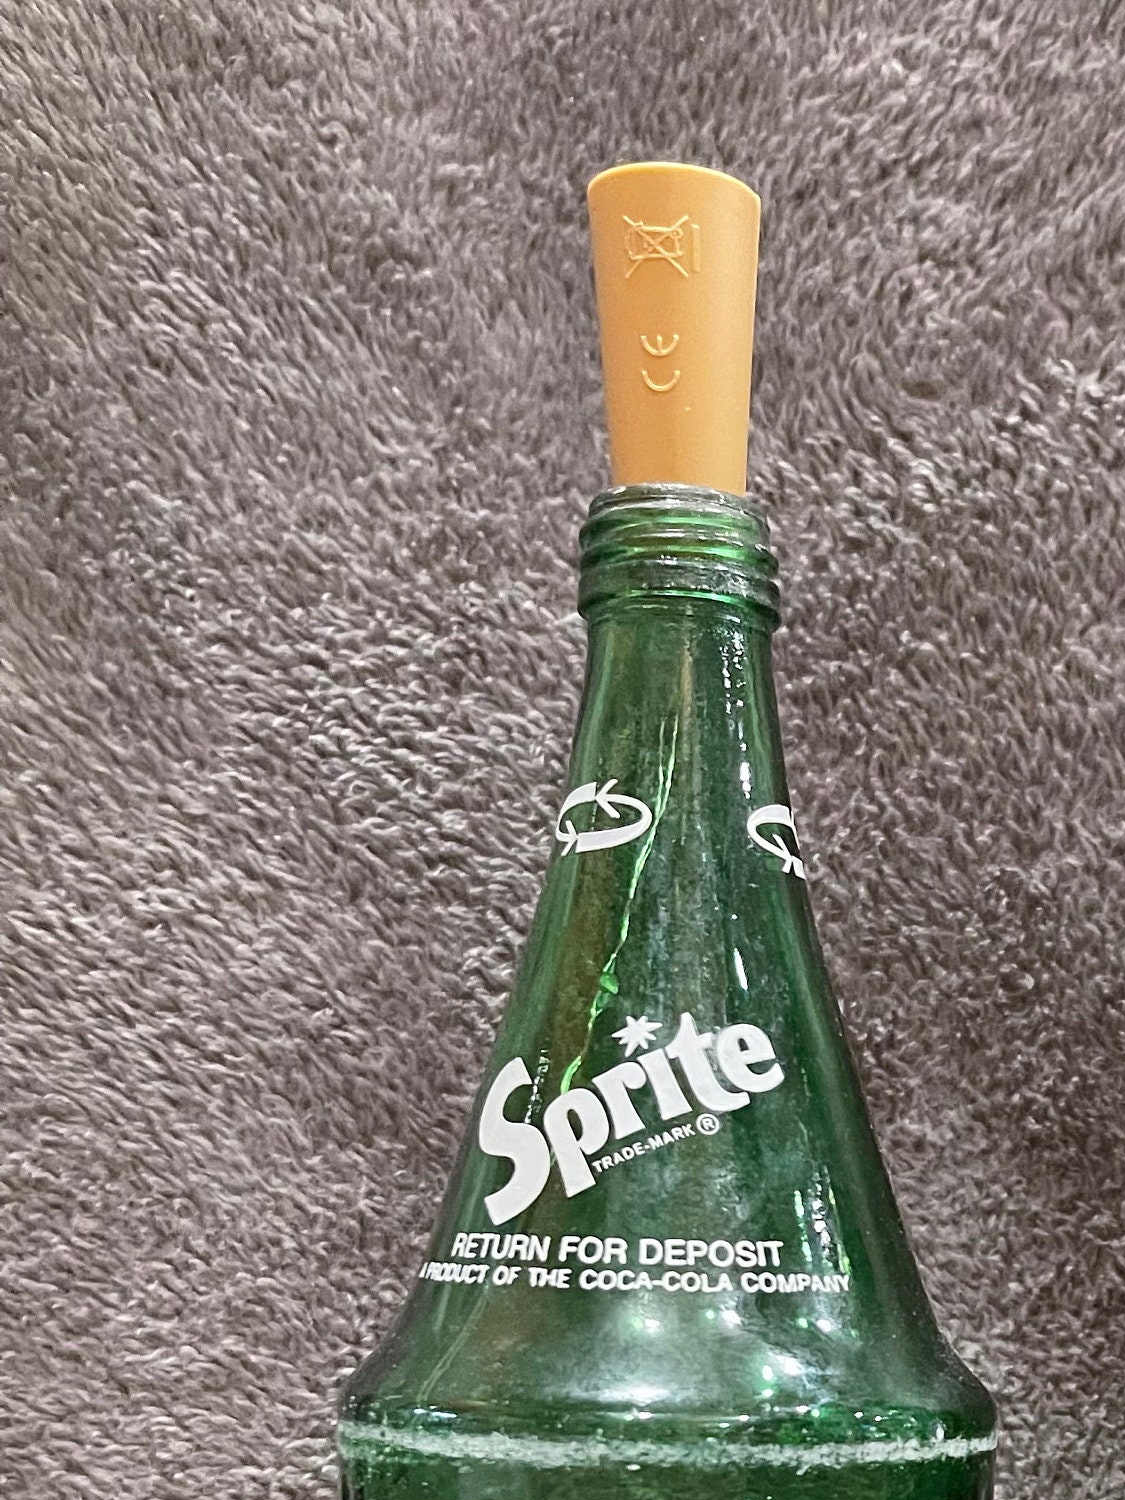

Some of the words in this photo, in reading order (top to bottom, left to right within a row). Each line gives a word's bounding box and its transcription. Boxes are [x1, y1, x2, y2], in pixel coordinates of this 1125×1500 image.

[479, 1012, 785, 1226] Sprite
[592, 1123, 696, 1173] TRADE-MARK
[451, 1232, 551, 1262] RETURN
[558, 1236, 628, 1264] FOR
[639, 1238, 784, 1267] DEPOSIT
[425, 1262, 490, 1284] PRODUCT
[492, 1265, 521, 1286] OF
[528, 1267, 572, 1289] THE
[579, 1269, 733, 1293] COCA-COLA
[740, 1271, 850, 1294] COMPANY
